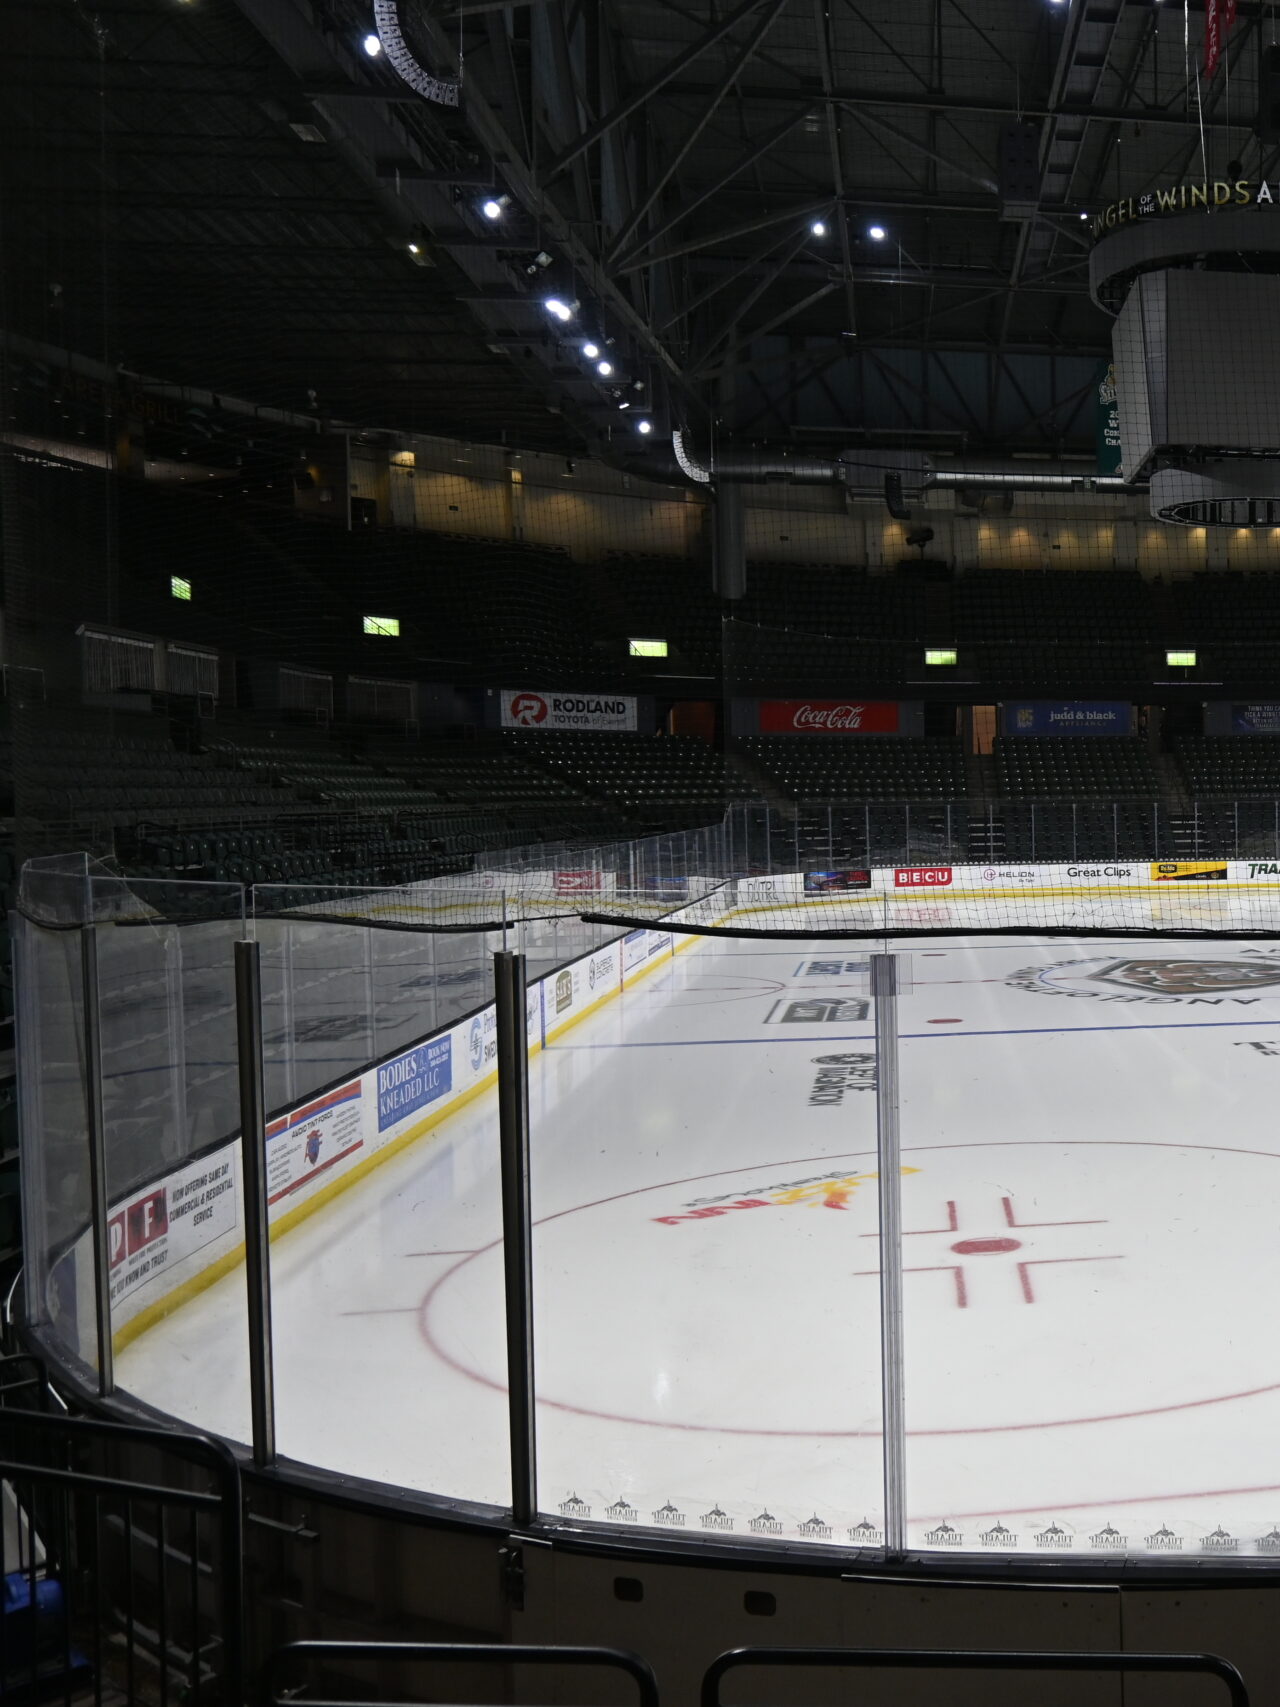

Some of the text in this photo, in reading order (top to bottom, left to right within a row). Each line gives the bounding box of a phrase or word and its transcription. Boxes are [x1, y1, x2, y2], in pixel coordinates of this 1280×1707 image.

[1141, 194, 1152, 204] OF
[1157, 180, 1250, 212] WINDS
[1138, 203, 1155, 214] THE
[553, 699, 626, 714] RODLAND
[1049, 710, 1116, 722] judd & black
[554, 715, 590, 724] TOYOTA
[898, 871, 948, 883] BECU
[1067, 867, 1131, 879] Great Clips
[379, 1054, 417, 1094] BODIES
[380, 1068, 439, 1117] KNEADED LLC
[172, 1162, 229, 1204] NOW OFFERING SAME DAY
[169, 1201, 200, 1223] COMMERCIAL
[206, 1179, 233, 1203] RESIDENTIAL
[143, 1201, 154, 1239] F
[193, 1206, 213, 1227] SERVICE
[125, 1272, 140, 1288] KNOW
[140, 1262, 150, 1277] AND
[151, 1250, 168, 1270] TRUST
